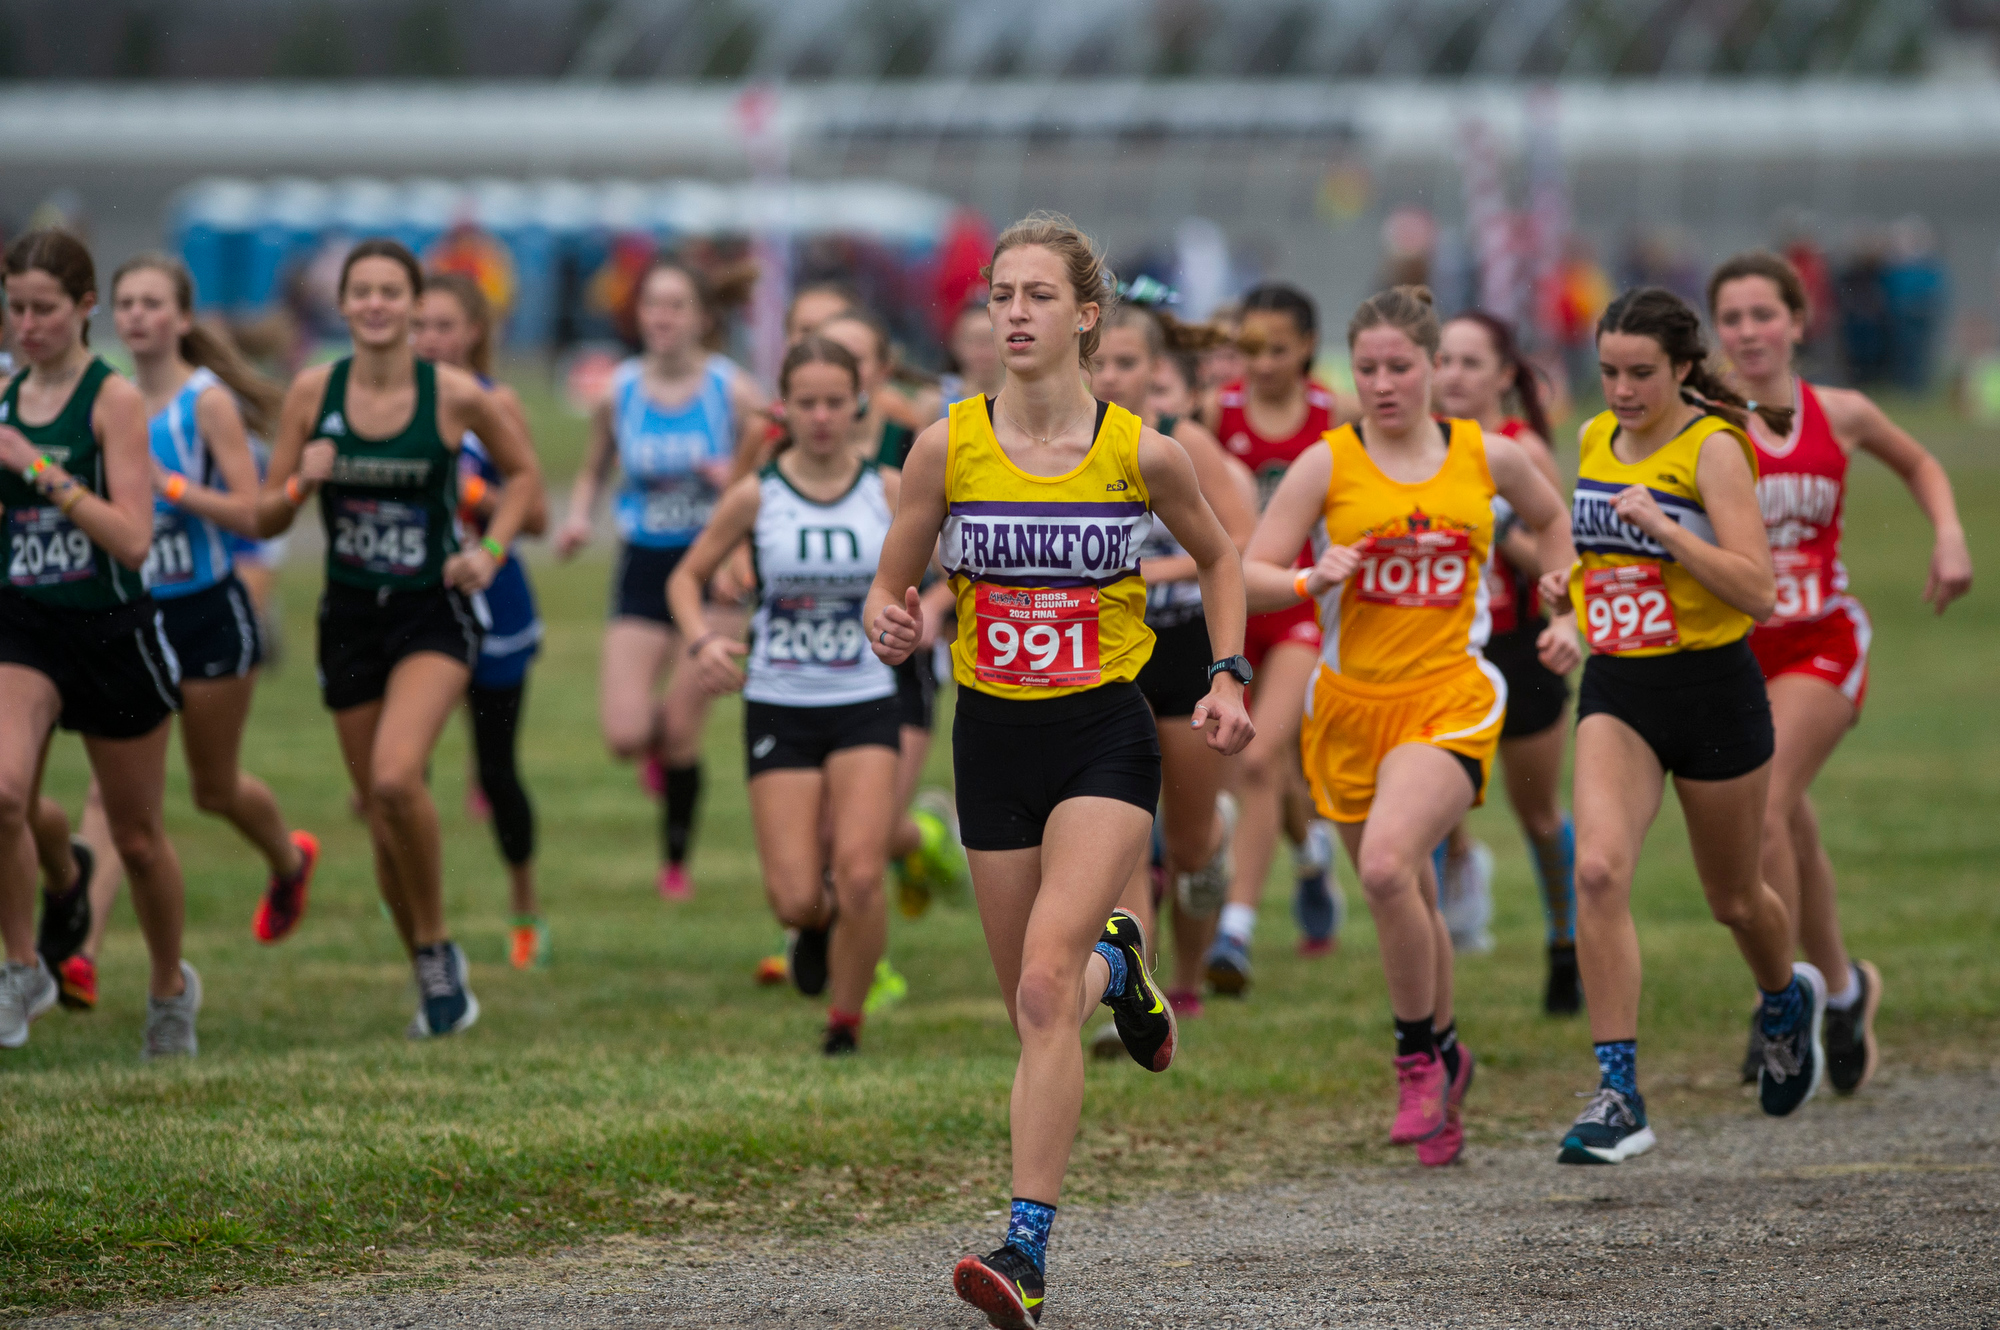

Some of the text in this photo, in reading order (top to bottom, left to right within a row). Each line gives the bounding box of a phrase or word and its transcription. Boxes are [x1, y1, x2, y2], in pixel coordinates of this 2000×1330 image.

[9, 529, 92, 576] 2049
[335, 517, 427, 567] 2045
[961, 522, 1133, 571] FRANKFORT
[1034, 593, 1067, 601] CROSS
[1361, 555, 1466, 595] 1019
[1774, 574, 1819, 617] 31
[1009, 609, 1058, 619] 2022 FINAL
[1034, 600, 1080, 608] COUNTRY
[1588, 590, 1672, 642] 992
[768, 617, 862, 661] 2069
[987, 622, 1084, 671] 991
